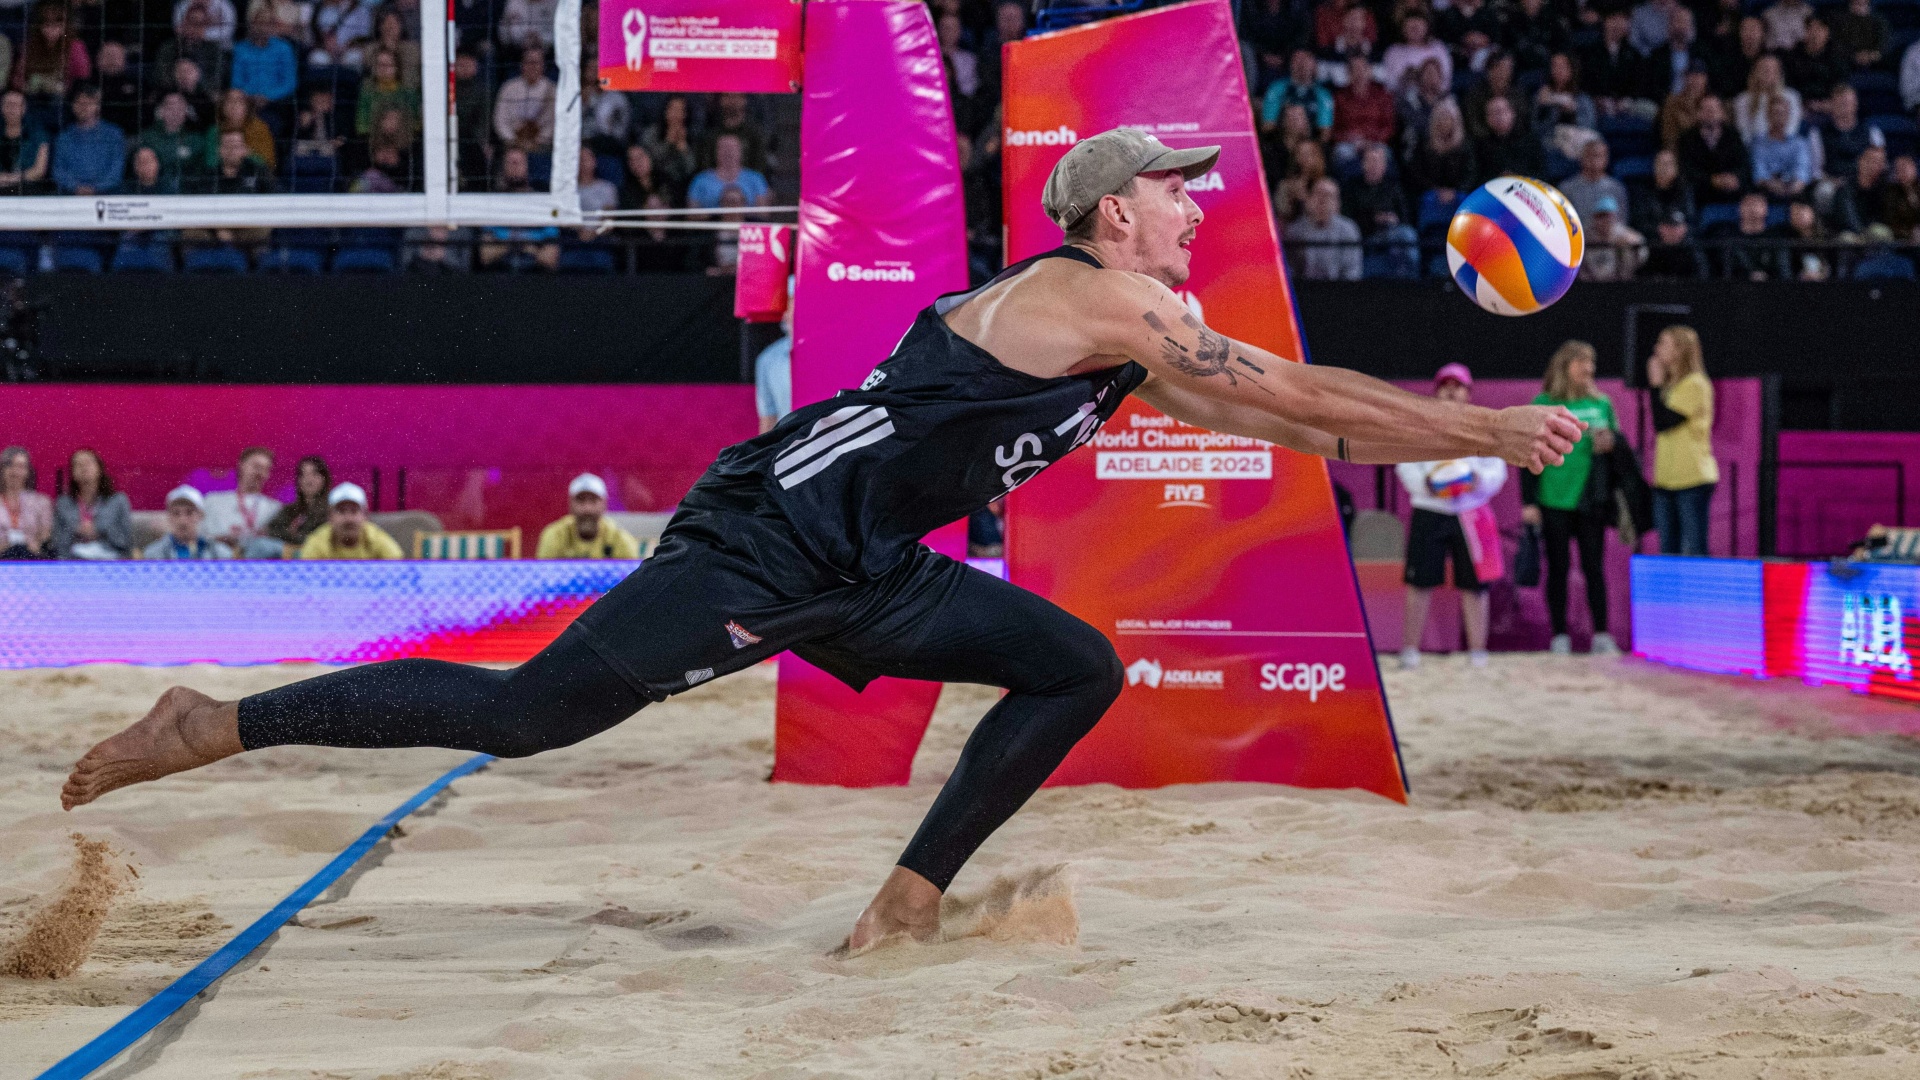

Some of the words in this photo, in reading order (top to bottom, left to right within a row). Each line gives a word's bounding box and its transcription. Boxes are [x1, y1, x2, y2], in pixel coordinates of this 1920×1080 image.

[656, 42, 727, 54] ADELAIDE
[1184, 171, 1225, 191] SA
[1130, 413, 1174, 428] Beach
[1104, 457, 1203, 472] ADELAIDE
[1210, 457, 1264, 472] 2025
[1164, 484, 1205, 500] FIVB
[1260, 662, 1346, 703] scape
